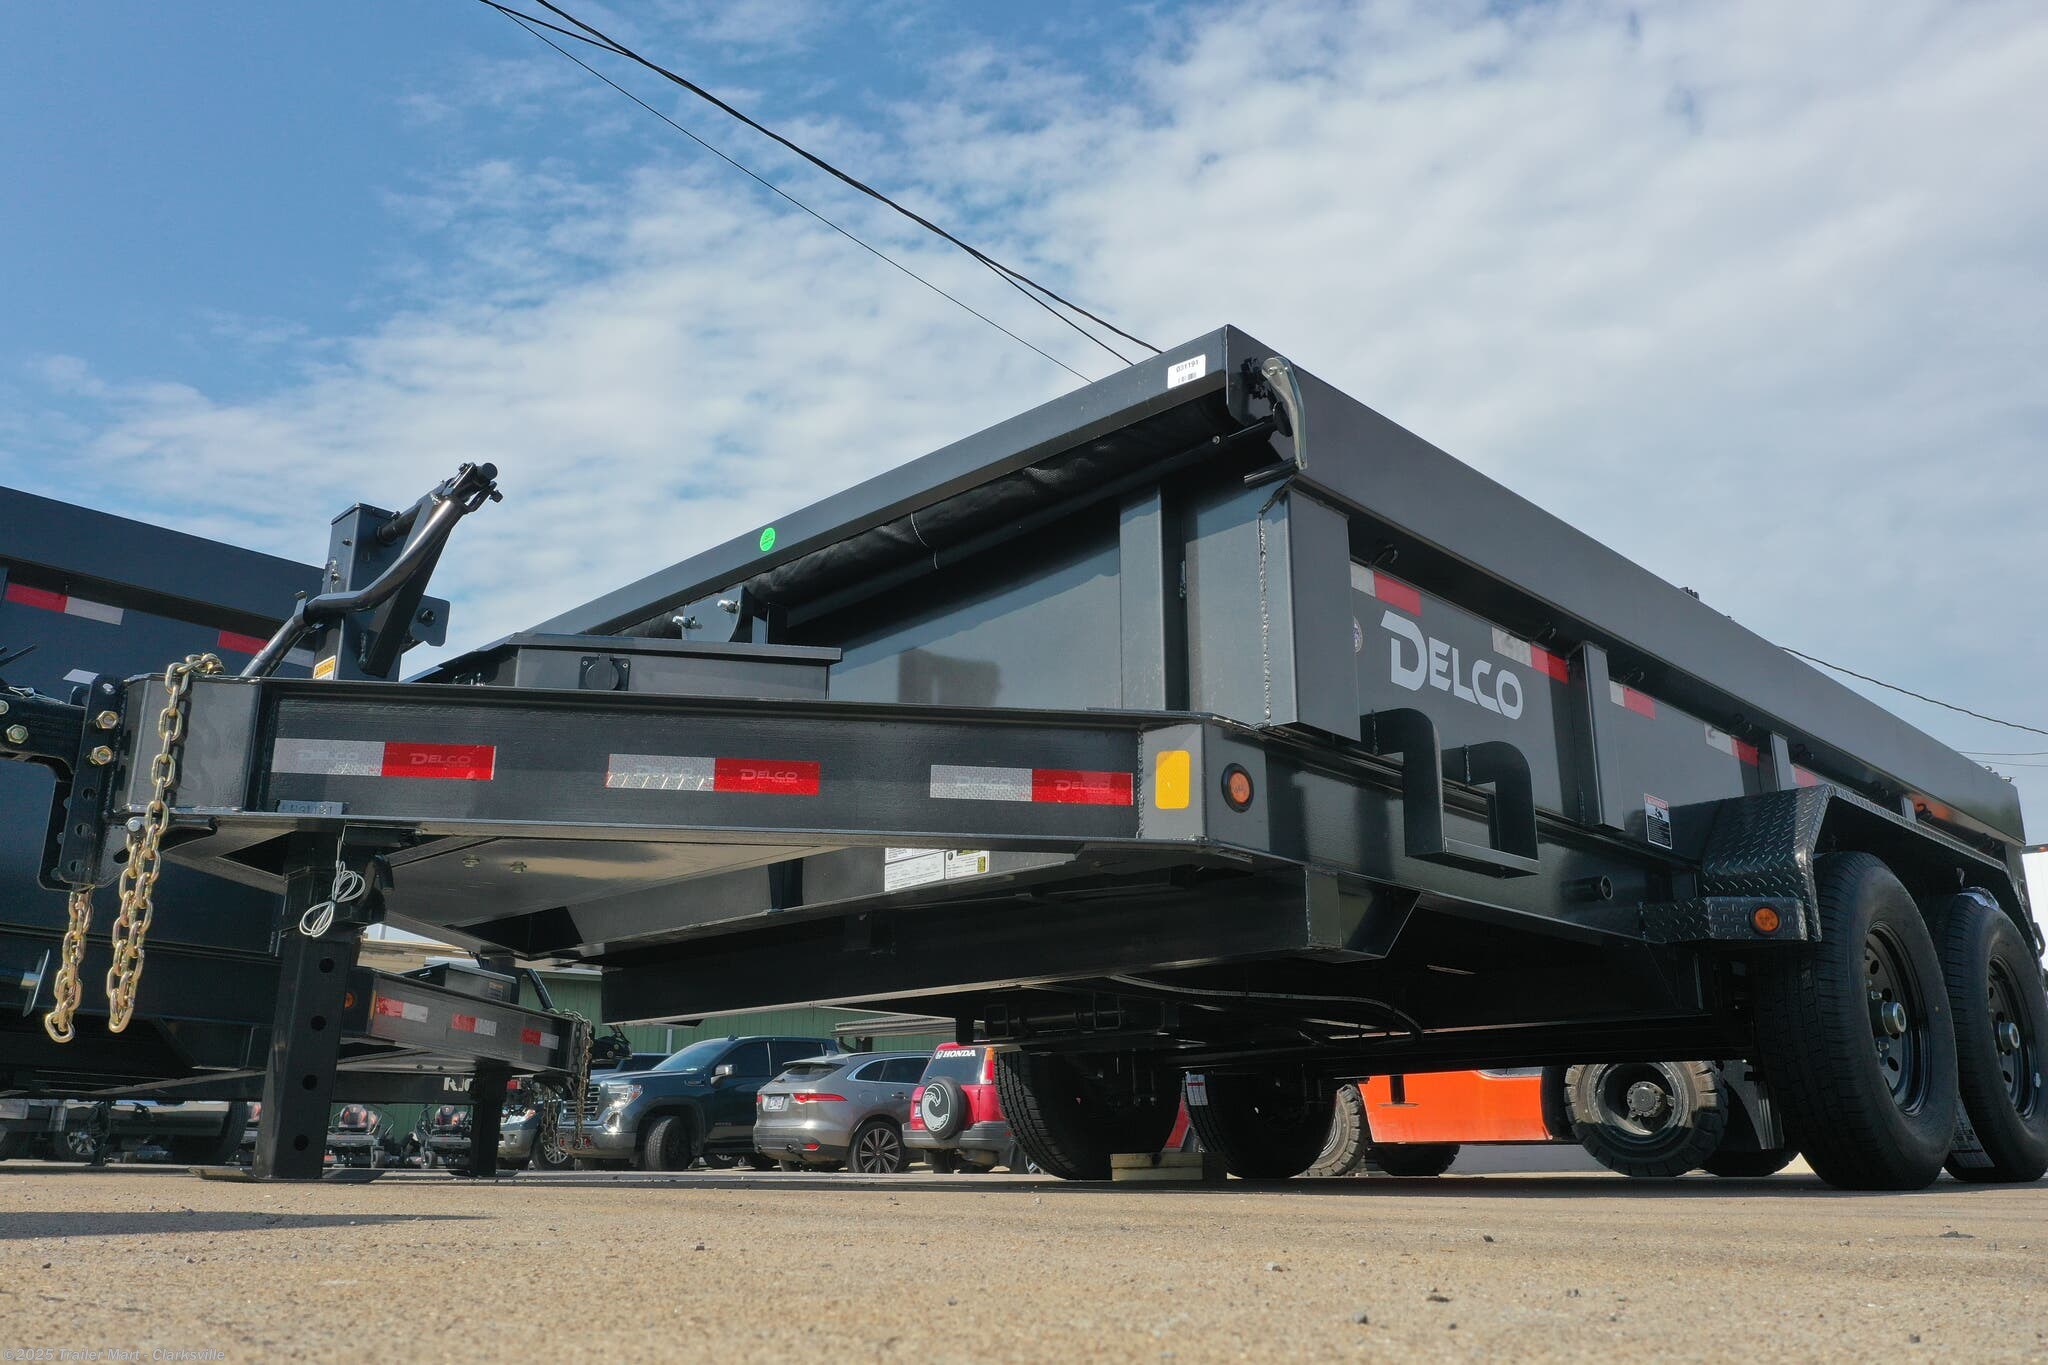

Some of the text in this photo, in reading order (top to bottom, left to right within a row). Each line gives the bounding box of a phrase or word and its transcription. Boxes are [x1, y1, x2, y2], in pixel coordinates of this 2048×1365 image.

[1380, 610, 1523, 720] DELCO
[409, 753, 471, 765] DELCO
[740, 768, 798, 781] DELCO
[1055, 779, 1110, 791] DELCO
[943, 1049, 976, 1058] HONDA
